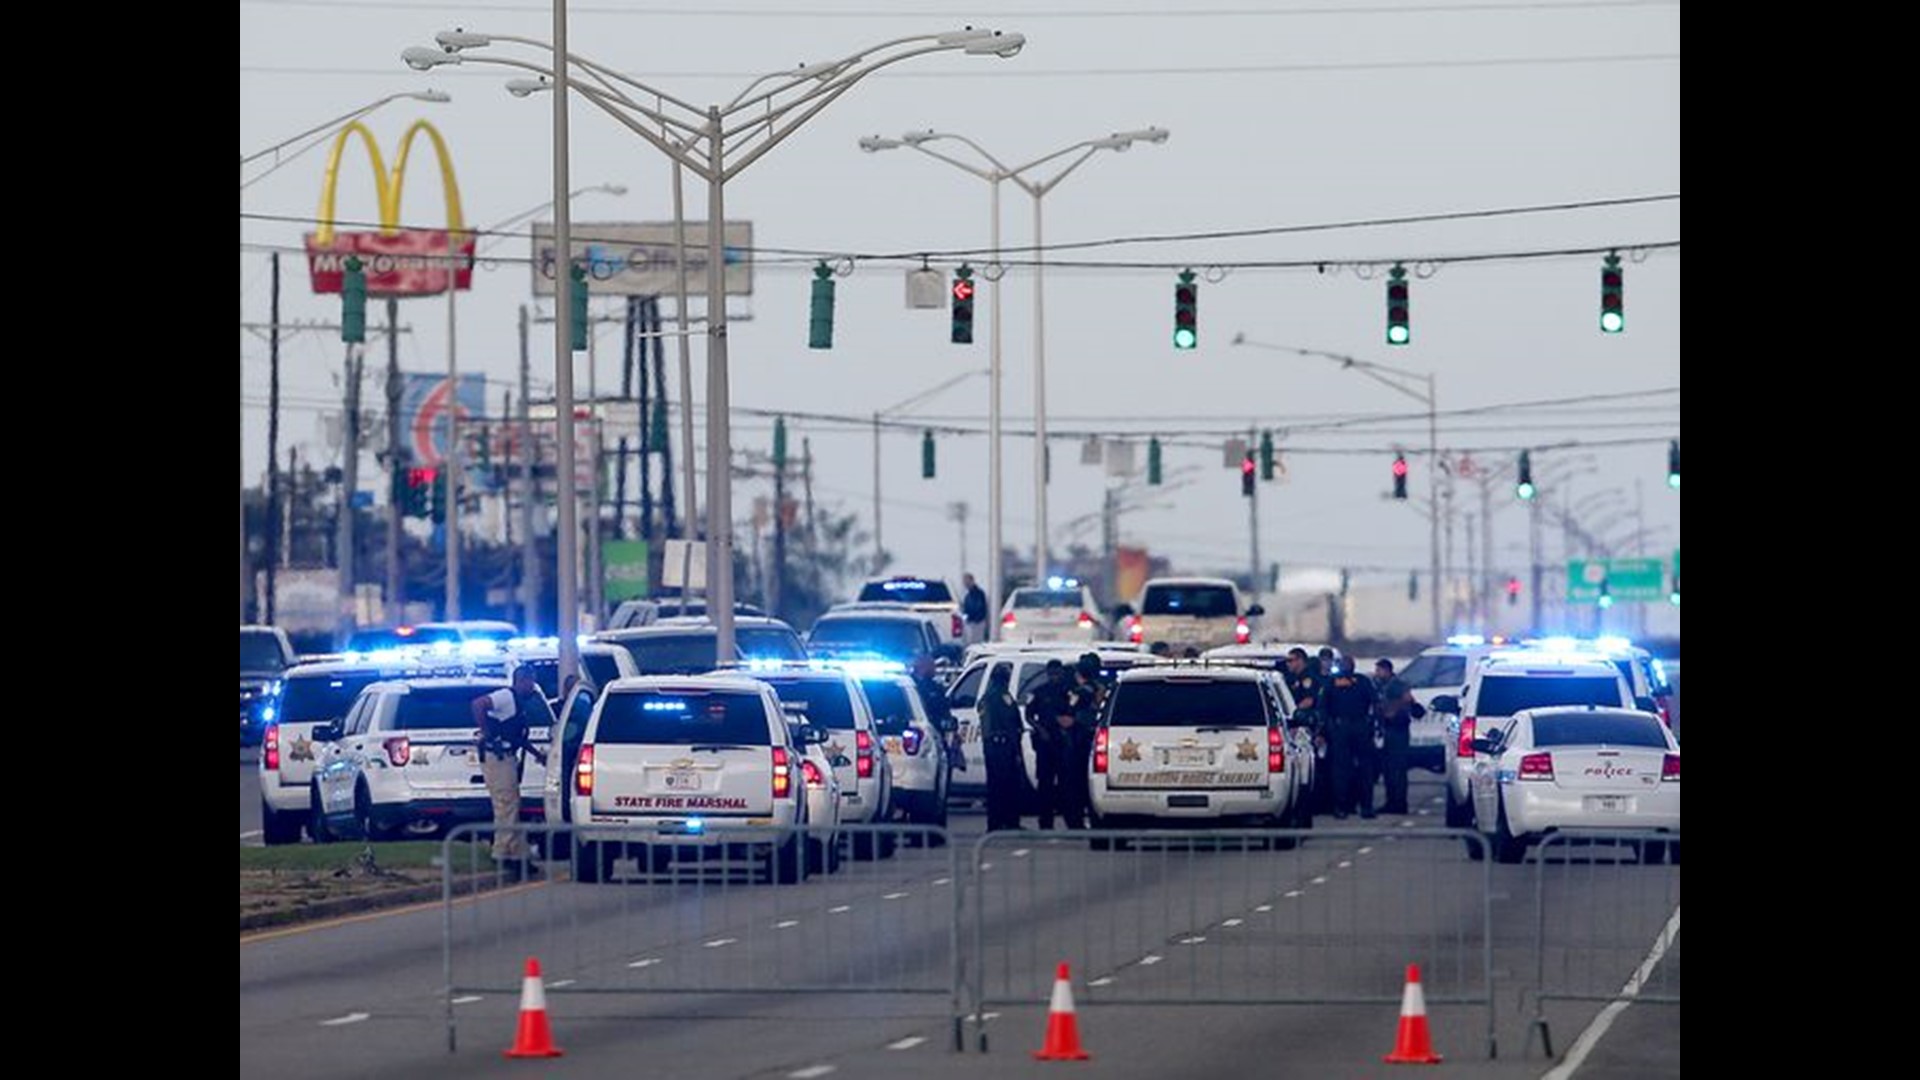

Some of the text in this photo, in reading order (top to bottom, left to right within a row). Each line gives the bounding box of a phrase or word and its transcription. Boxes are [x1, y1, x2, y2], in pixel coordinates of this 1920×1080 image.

[1584, 766, 1634, 777] POLICE
[1217, 772, 1261, 784] SHERIFF
[615, 796, 748, 809] STATE FIRE MARSHAL
